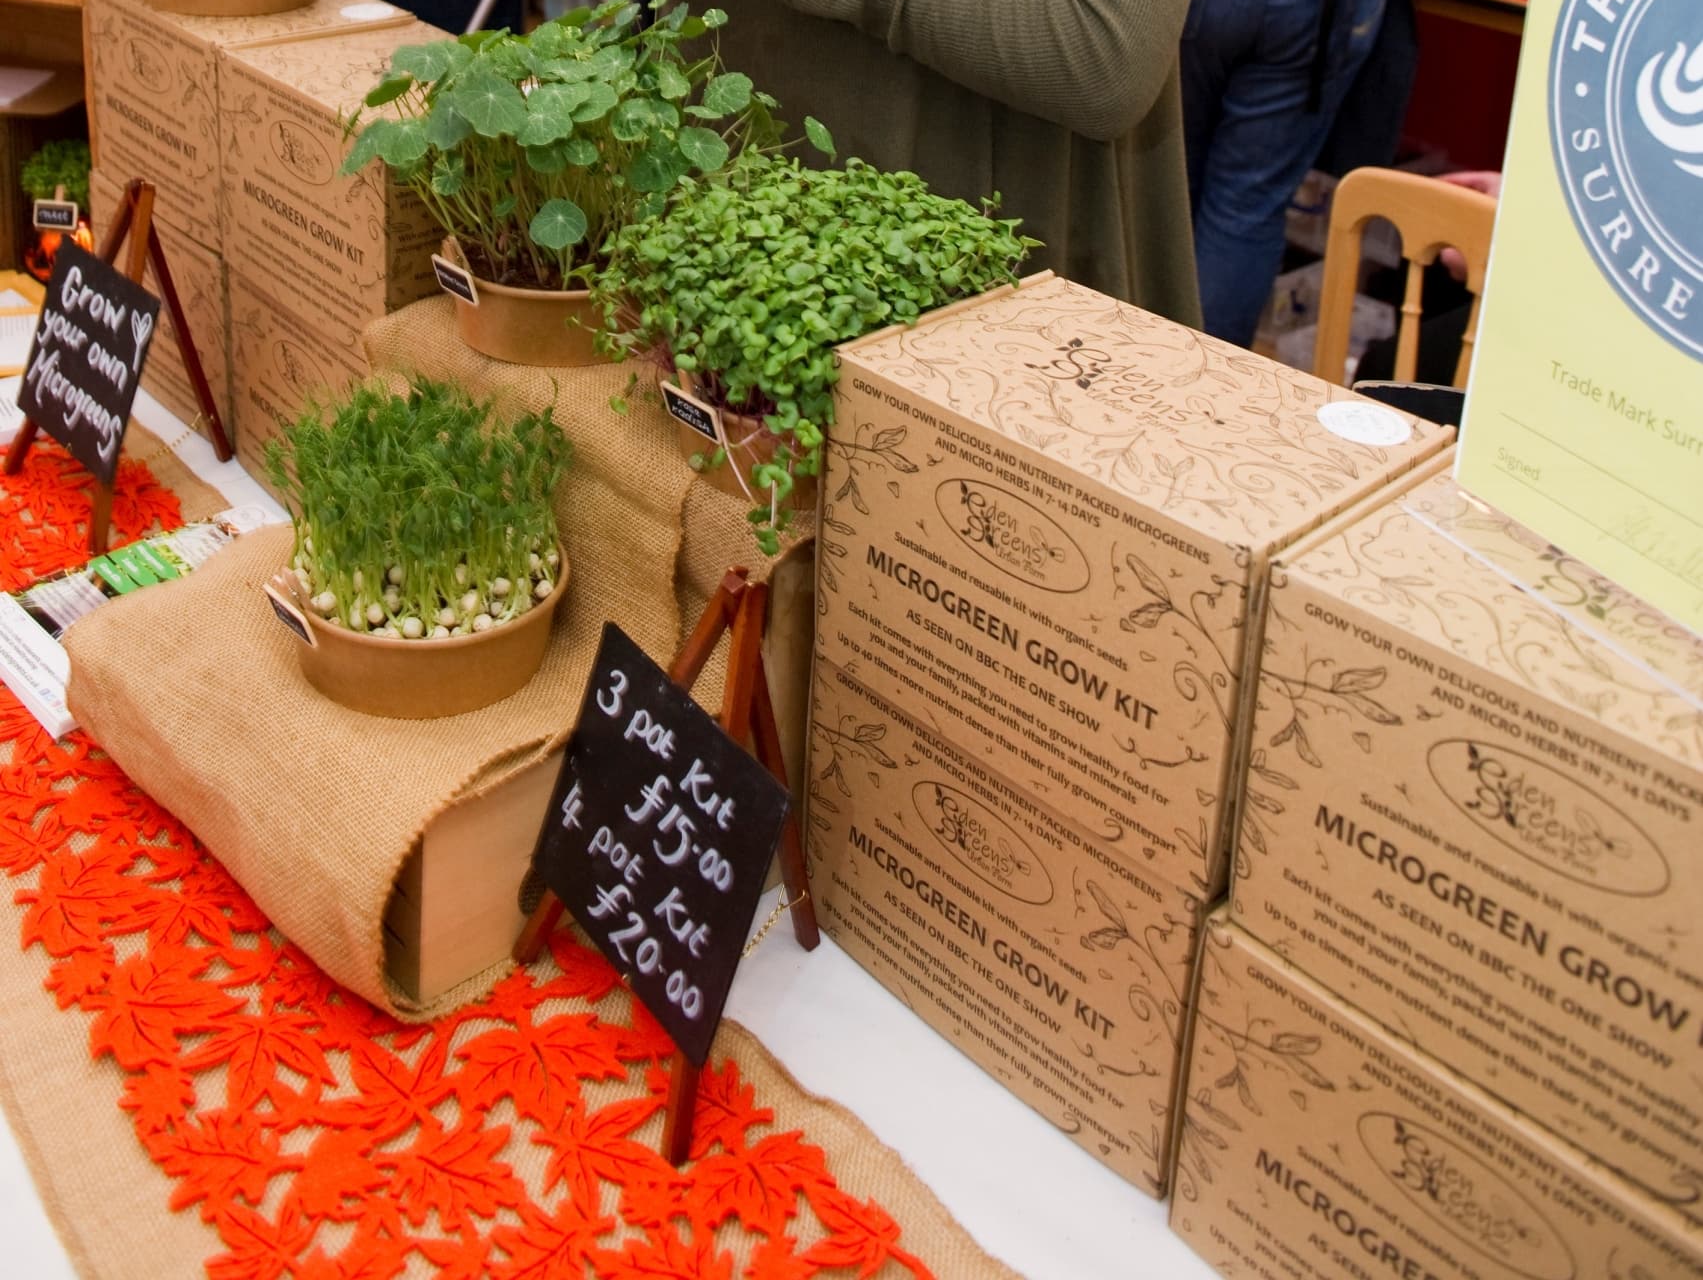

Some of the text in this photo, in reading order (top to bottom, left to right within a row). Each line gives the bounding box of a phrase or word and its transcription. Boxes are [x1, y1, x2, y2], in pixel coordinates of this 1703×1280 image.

[242, 178, 364, 267] MICROGREEN GROW KIT
[37, 308, 128, 392] your own
[61, 264, 126, 332] Grow
[1549, 360, 1603, 402] Trade
[1607, 391, 1657, 433] Mark
[852, 377, 1210, 565] GROW YOUR OWN DELICIOUS AND NUTRIENT PACKED MICROGREENS
[934, 436, 1101, 528] AND MICRO HERBS IN 7- 14 DAYS
[1497, 446, 1541, 482] Signed
[866, 544, 1158, 730] MICROGREEN GROW KIT
[894, 530, 1128, 672] Sustainable and reusable kit with organic seeds
[596, 669, 630, 718] 3
[624, 708, 677, 761] pot
[906, 608, 1100, 733] AS SEEN ON BBC THE ONE SHOW
[560, 779, 585, 831] 4
[587, 825, 644, 885] pot
[847, 825, 1114, 1041] MICROGREEN GROW KIT
[1314, 804, 1687, 1032] MICROGREEN GROW
[1372, 887, 1671, 1069] AS SEEN ON BBC THE ONE SHOW
